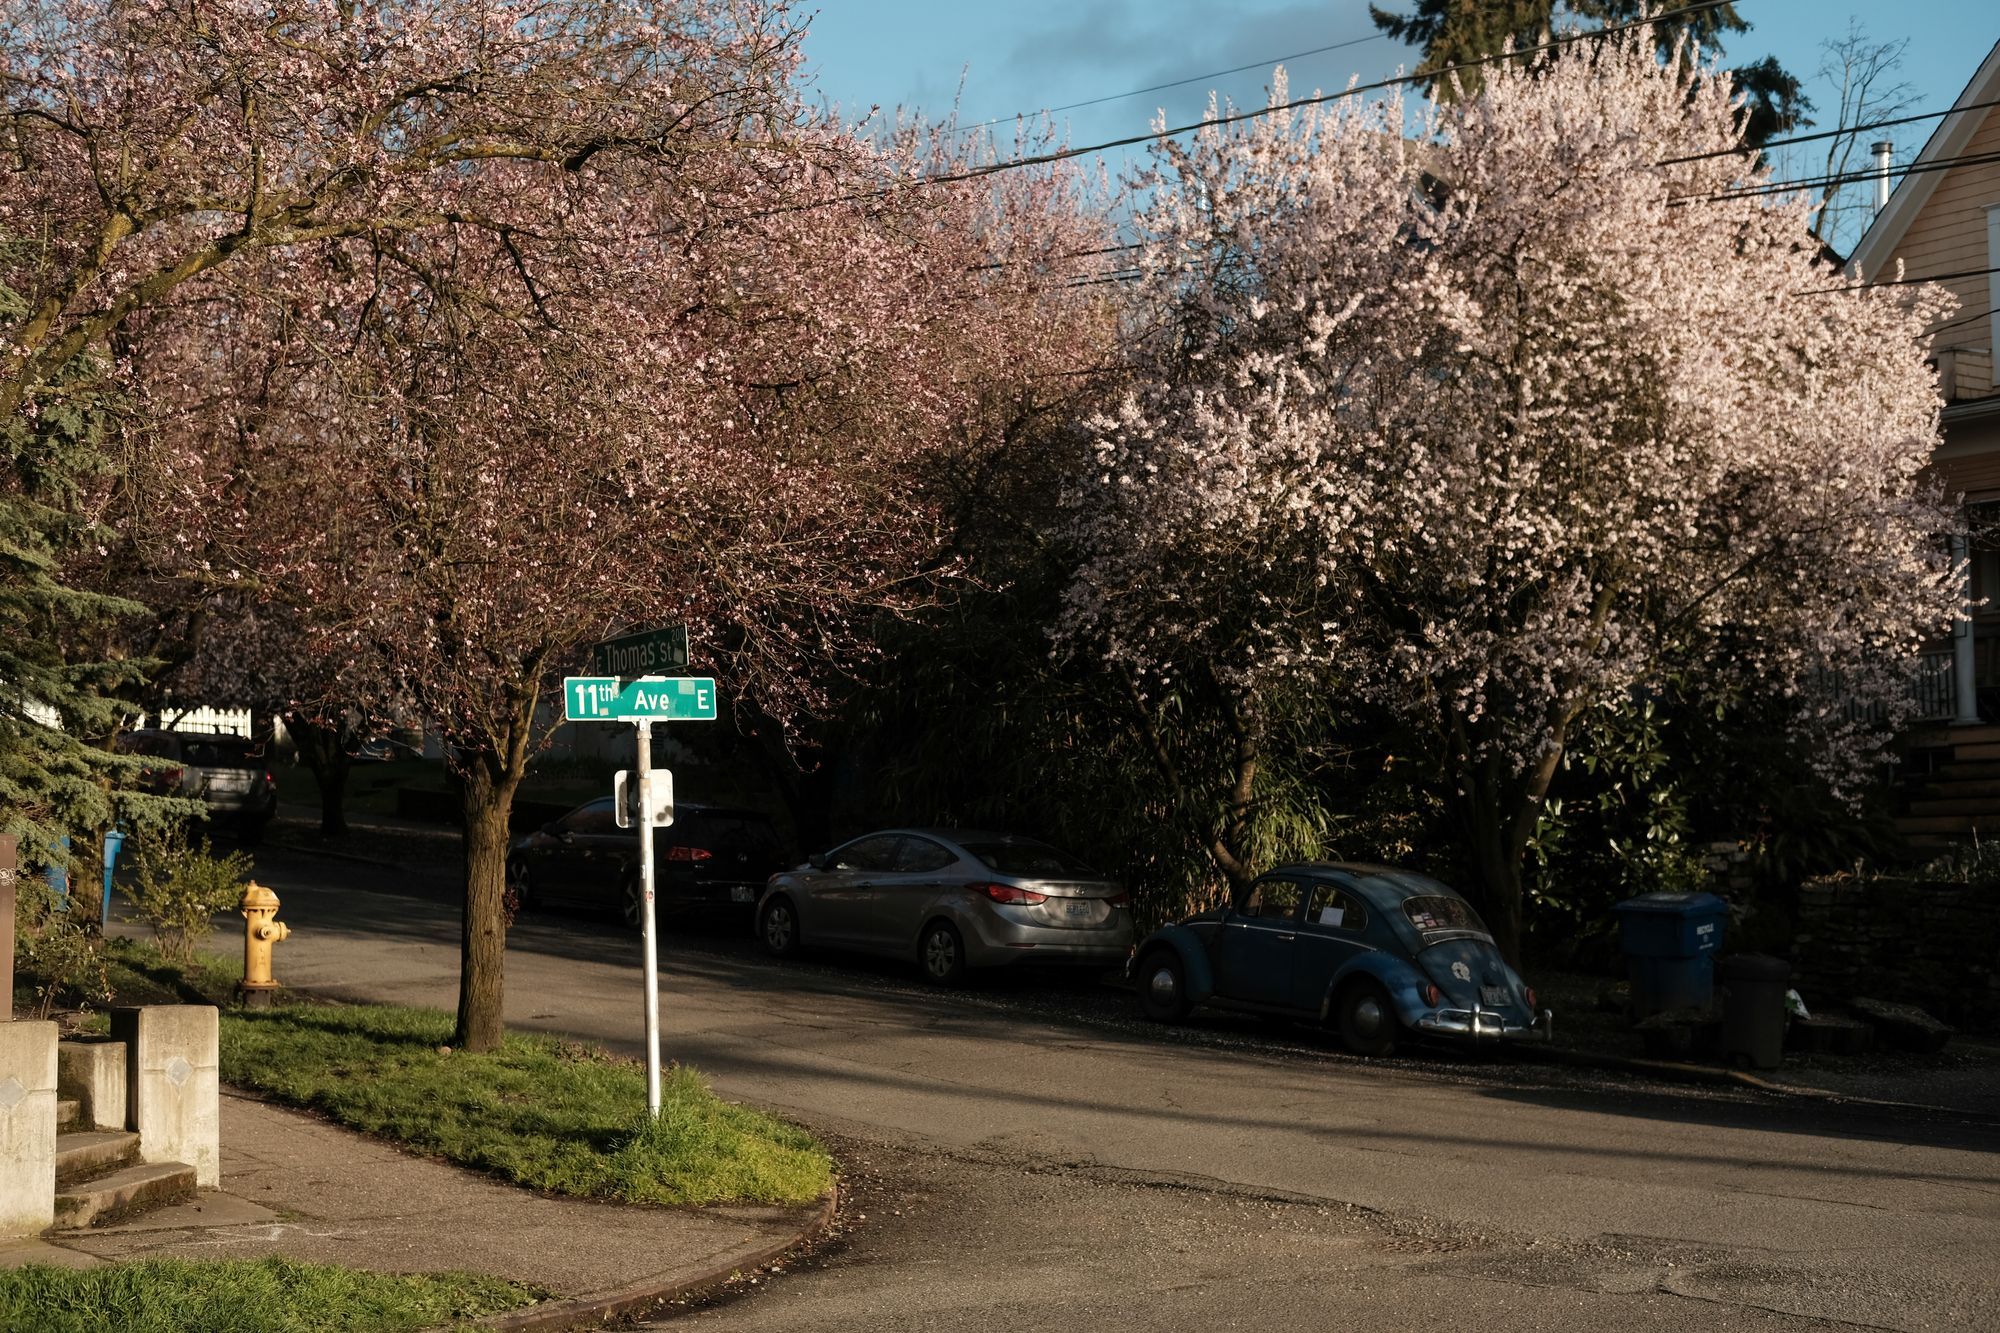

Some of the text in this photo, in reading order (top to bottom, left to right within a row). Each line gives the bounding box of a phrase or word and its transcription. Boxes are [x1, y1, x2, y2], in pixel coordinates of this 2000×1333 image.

[671, 628, 685, 642] 200
[596, 640, 672, 675] E Thomas St
[575, 684, 710, 715] 11th Ave E
